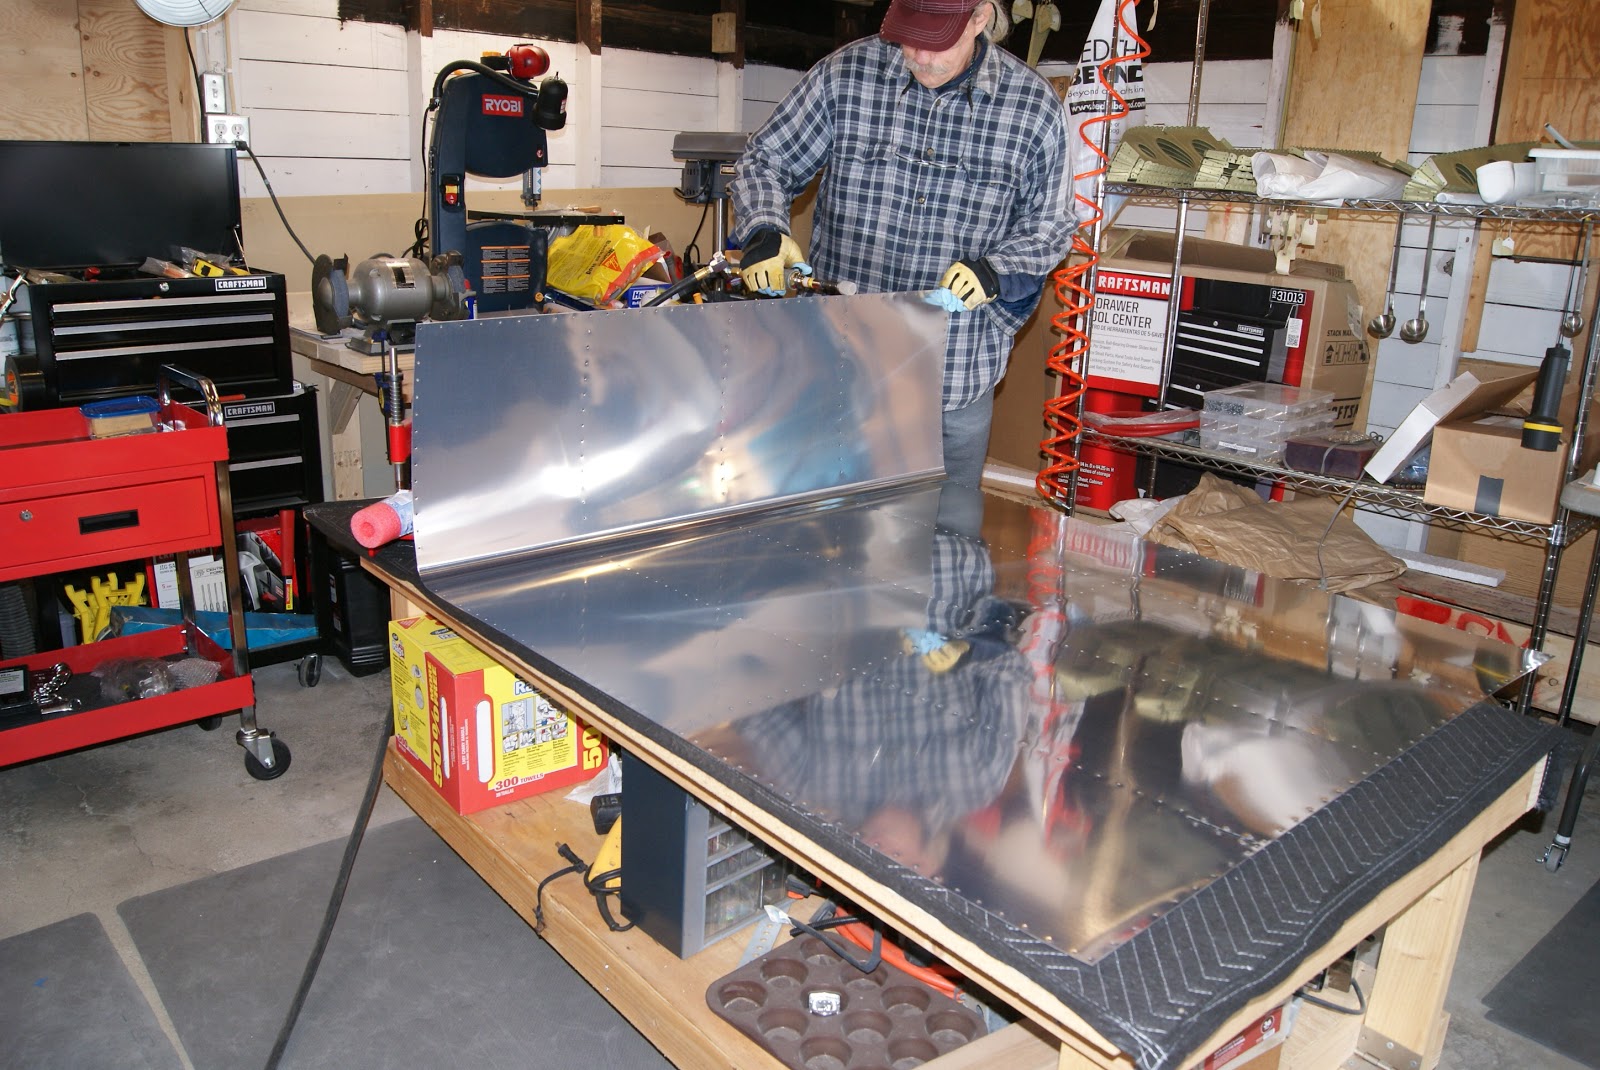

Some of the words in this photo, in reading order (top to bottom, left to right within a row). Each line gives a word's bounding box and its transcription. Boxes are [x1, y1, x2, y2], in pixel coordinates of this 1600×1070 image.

[485, 99, 522, 113] RYOBI
[218, 279, 264, 289] CRAFTSMAN
[1098, 275, 1171, 296] RAFTSMAN
[1095, 297, 1139, 314] -DRAWER
[1277, 290, 1304, 304] 31013
[1093, 310, 1109, 324] OOL
[1112, 313, 1152, 329] CENTER
[227, 404, 272, 416] CRAFTSMAN
[582, 726, 602, 770] 50
[496, 776, 519, 790] 300
[520, 773, 544, 783] TOWELS
